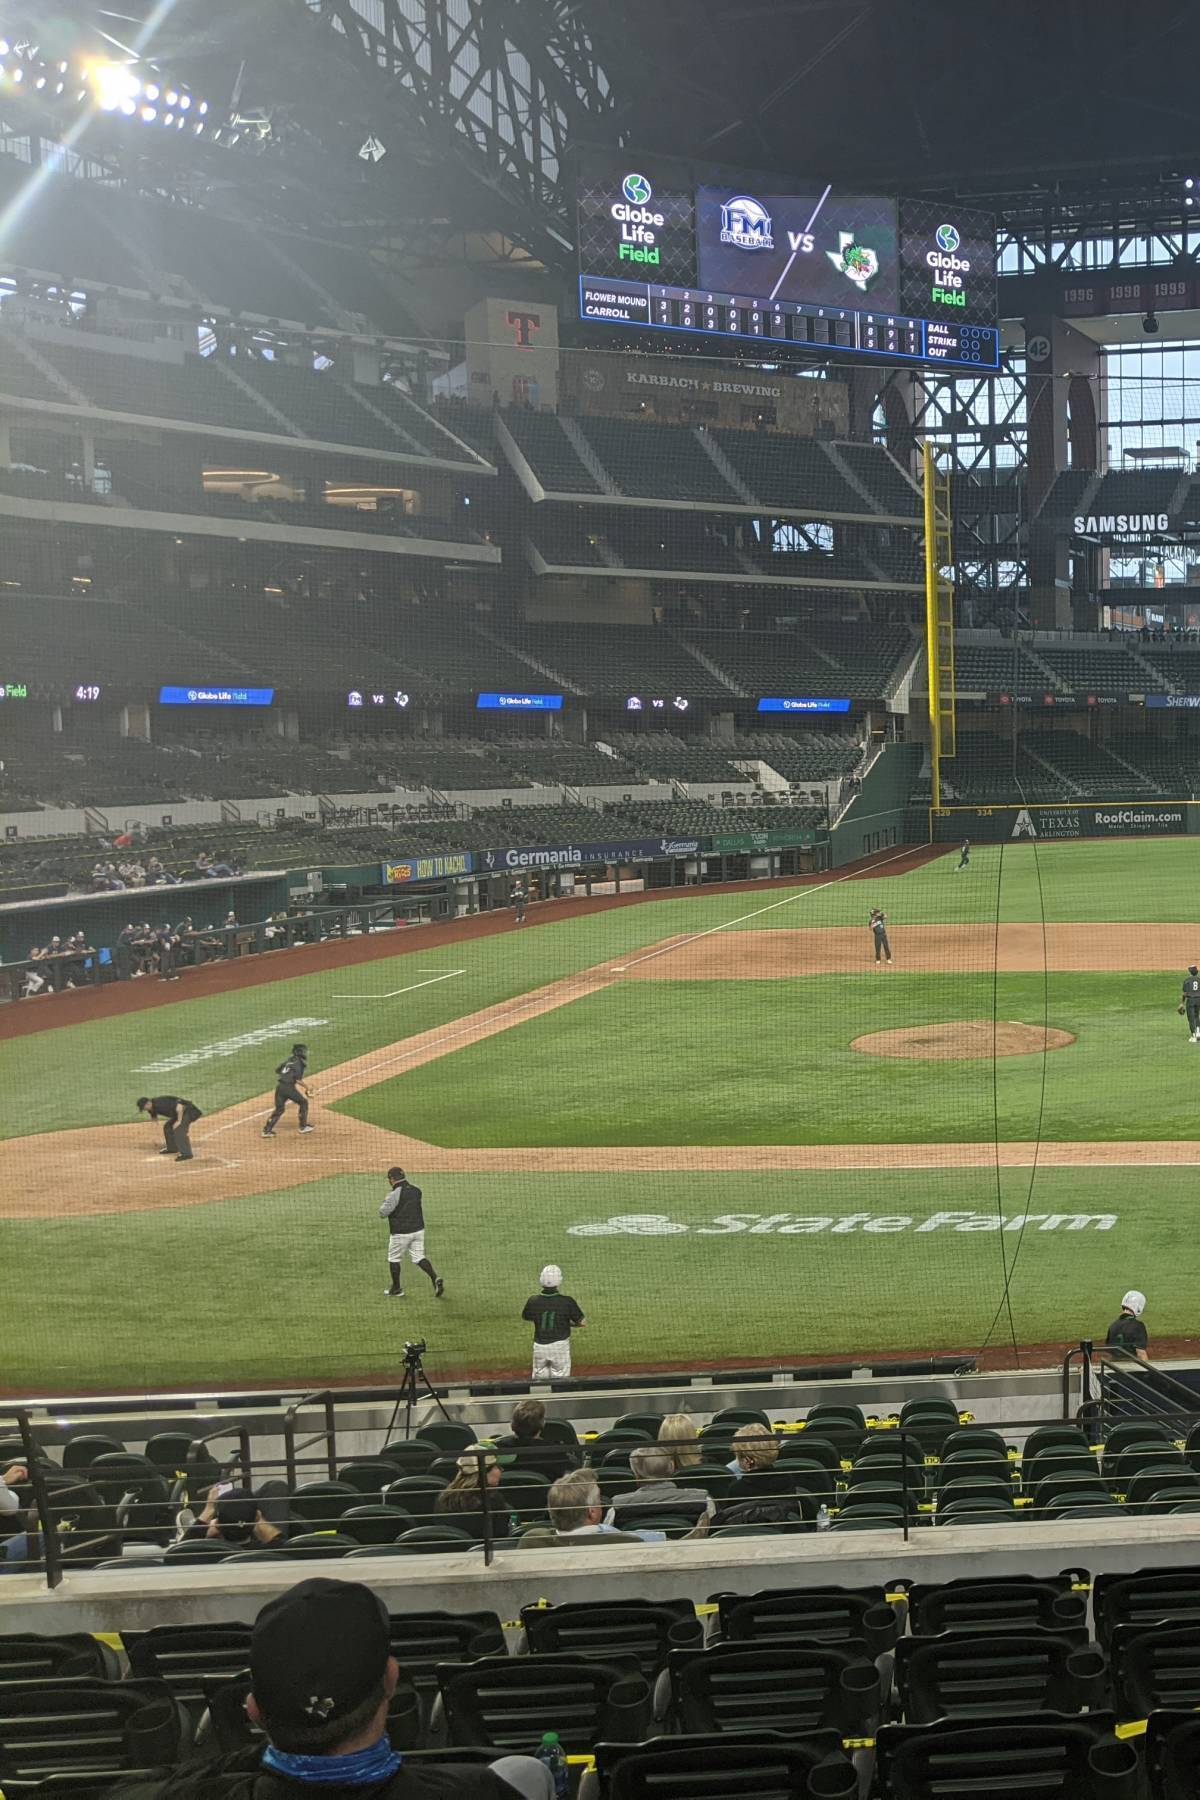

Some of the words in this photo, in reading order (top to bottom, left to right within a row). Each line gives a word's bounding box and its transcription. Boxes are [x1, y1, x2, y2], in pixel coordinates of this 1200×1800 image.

[611, 203, 664, 226] Globe
[720, 204, 772, 236] FM
[622, 223, 655, 245] Life
[720, 231, 774, 249] BASEBALL
[787, 231, 815, 253] VS
[618, 244, 660, 265] Field
[926, 251, 970, 273] Globe
[934, 268, 962, 288] Life
[585, 291, 616, 304] FLOWER
[617, 296, 647, 307] MOUND
[932, 288, 966, 307] Field
[586, 305, 630, 319] CARROLL
[928, 323, 949, 334] BALL
[928, 336, 957, 347] STRIKE
[1030, 340, 1048, 356] 42
[928, 348, 947, 357] OUT
[627, 372, 699, 390] KARBACH
[713, 382, 781, 398] BREWING
[1074, 513, 1169, 534] SAMSUNG
[5, 684, 27, 697] Field
[76, 686, 100, 700] 4:19
[1040, 817, 1080, 829] TEXAS
[1095, 809, 1182, 824] RoofClaim.com
[1040, 830, 1080, 838] ARLINGTON
[506, 846, 582, 866] Germania
[583, 849, 643, 860] INSURANCE
[416, 860, 433, 877] HOW
[434, 859, 442, 874] TO
[1192, 980, 1199, 991] 8
[541, 1310, 556, 1329] 11
